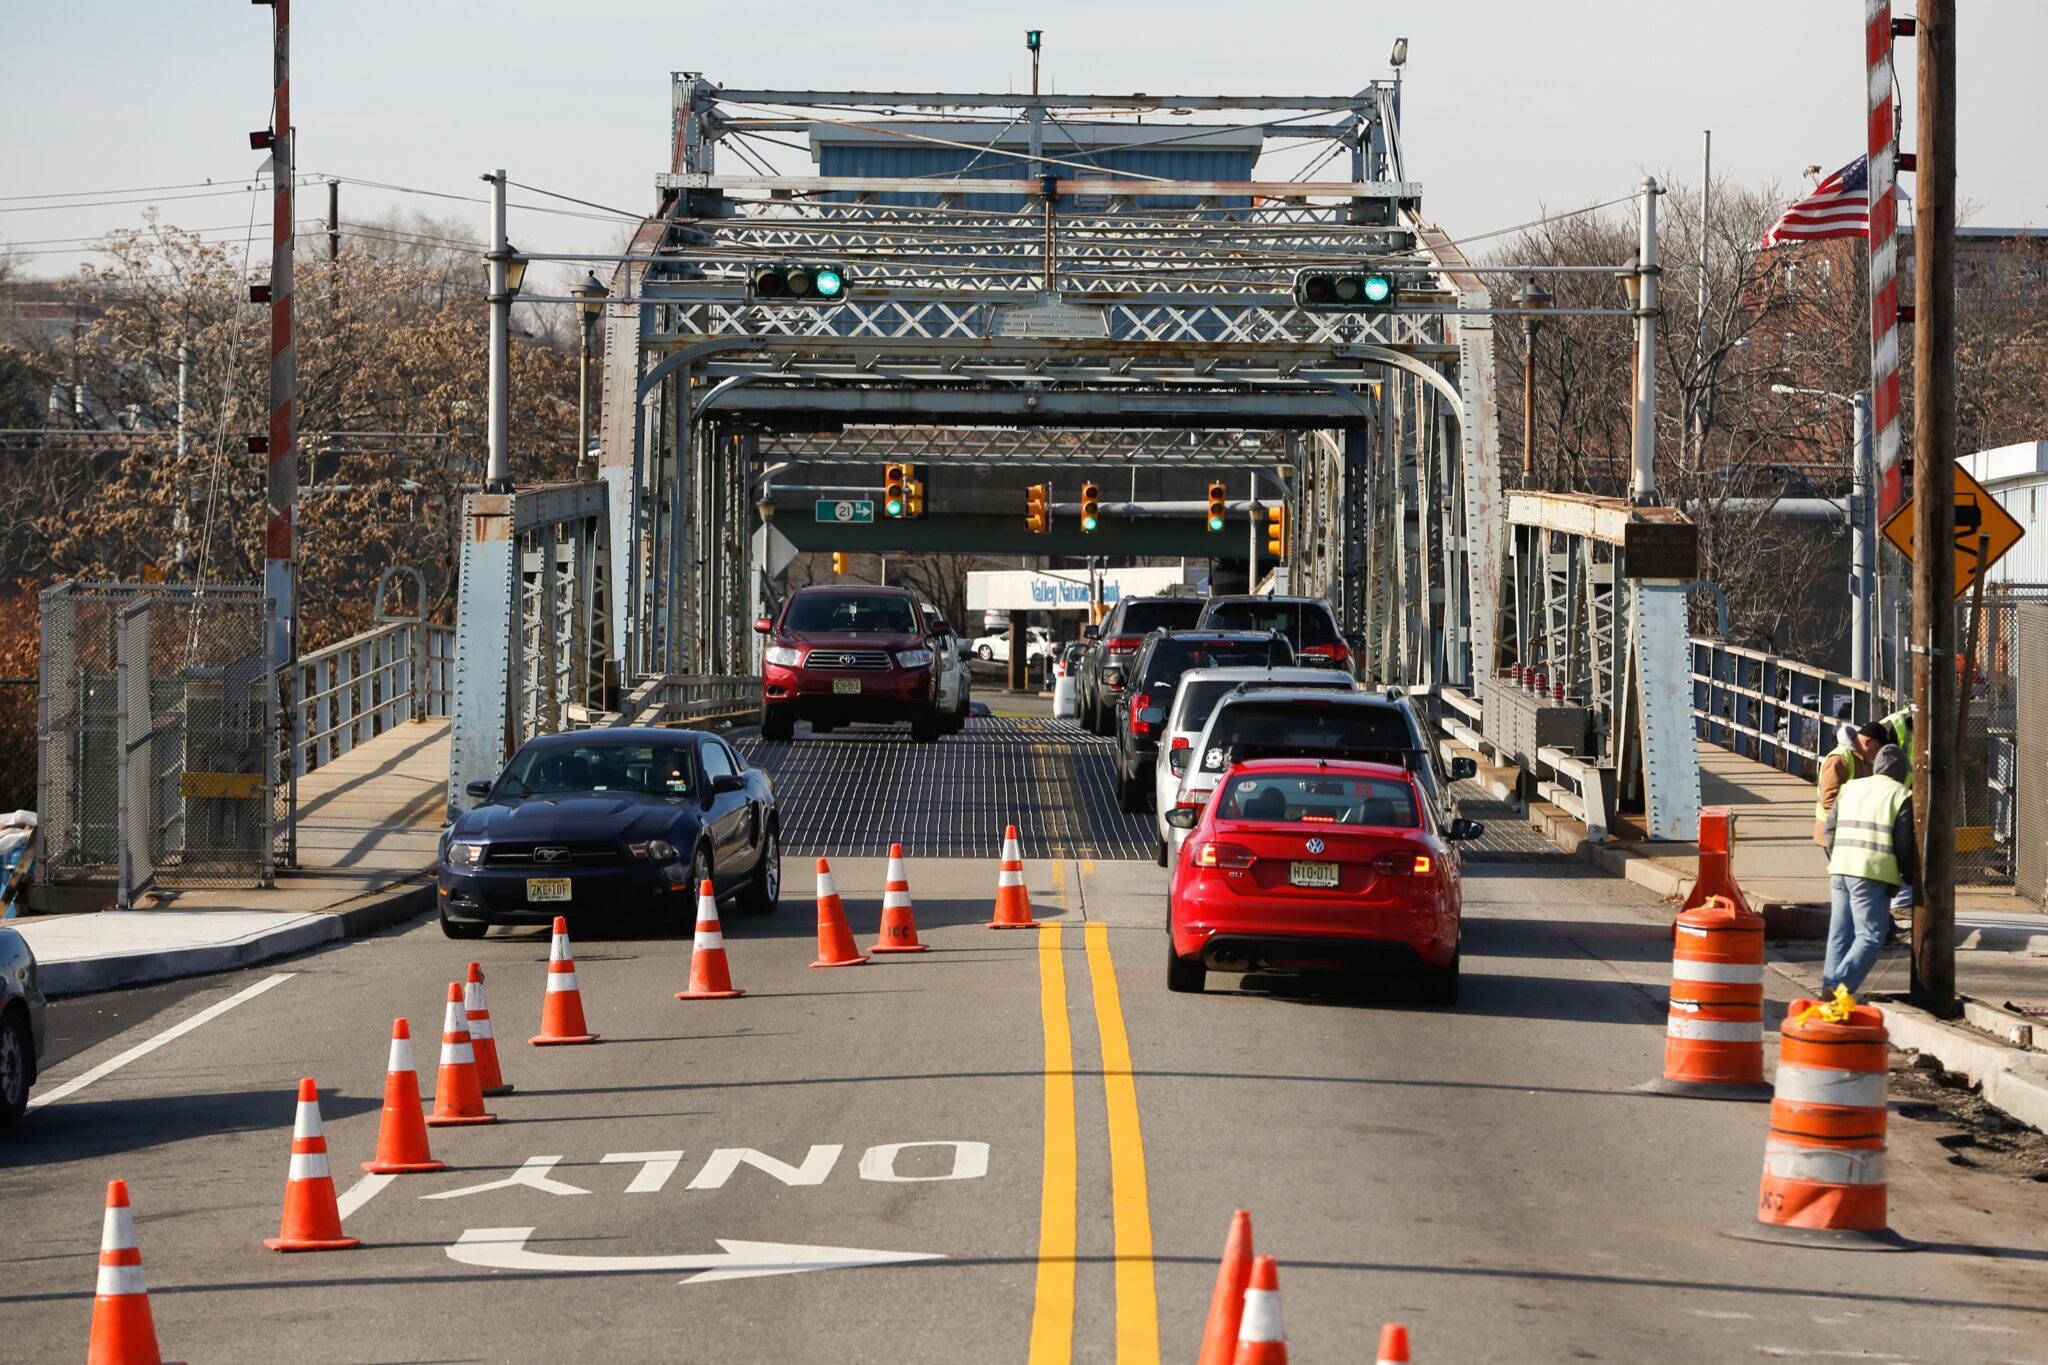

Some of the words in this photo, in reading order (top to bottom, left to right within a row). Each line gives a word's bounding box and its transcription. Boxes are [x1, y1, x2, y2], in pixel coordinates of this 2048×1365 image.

[839, 506, 850, 517] 21
[855, 502, 861, 510] N
[1031, 578, 1057, 608] Valley
[1058, 580, 1090, 603] Nation
[1102, 579, 1121, 602] ank
[417, 1140, 992, 1200] ONLY
